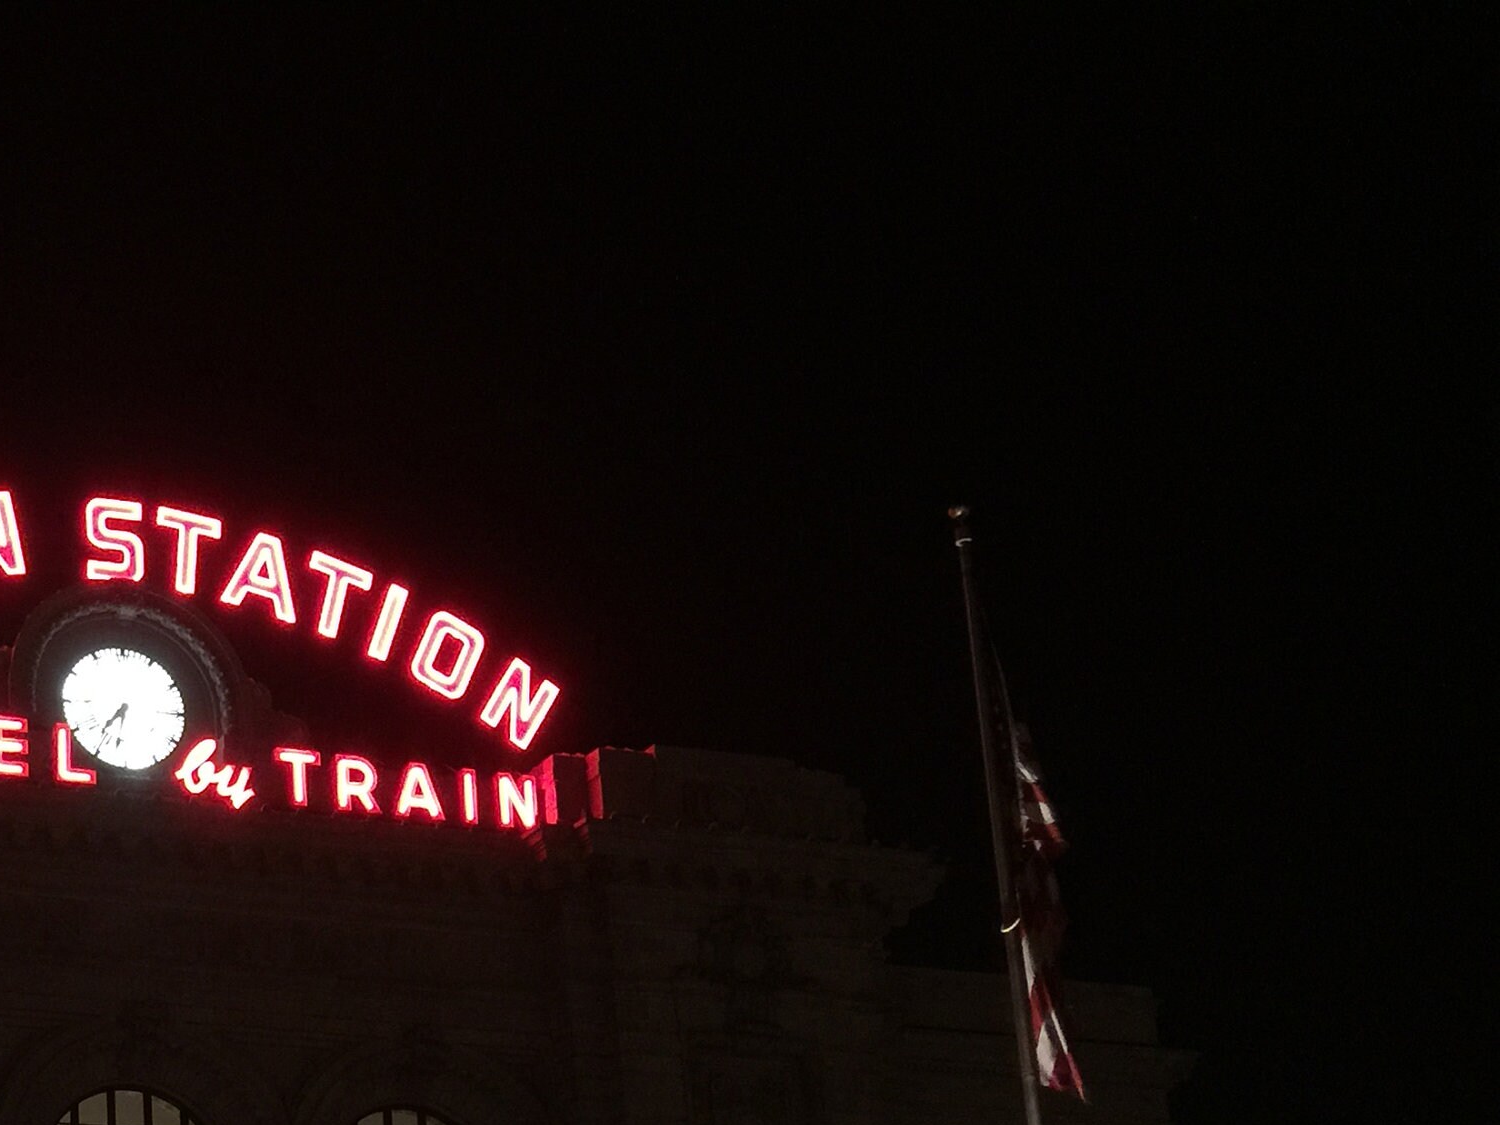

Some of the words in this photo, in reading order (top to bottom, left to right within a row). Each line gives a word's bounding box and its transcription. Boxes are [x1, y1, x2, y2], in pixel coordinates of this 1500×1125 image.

[84, 497, 560, 751] STATION
[175, 738, 256, 810] by
[273, 747, 537, 830] TRAIN
